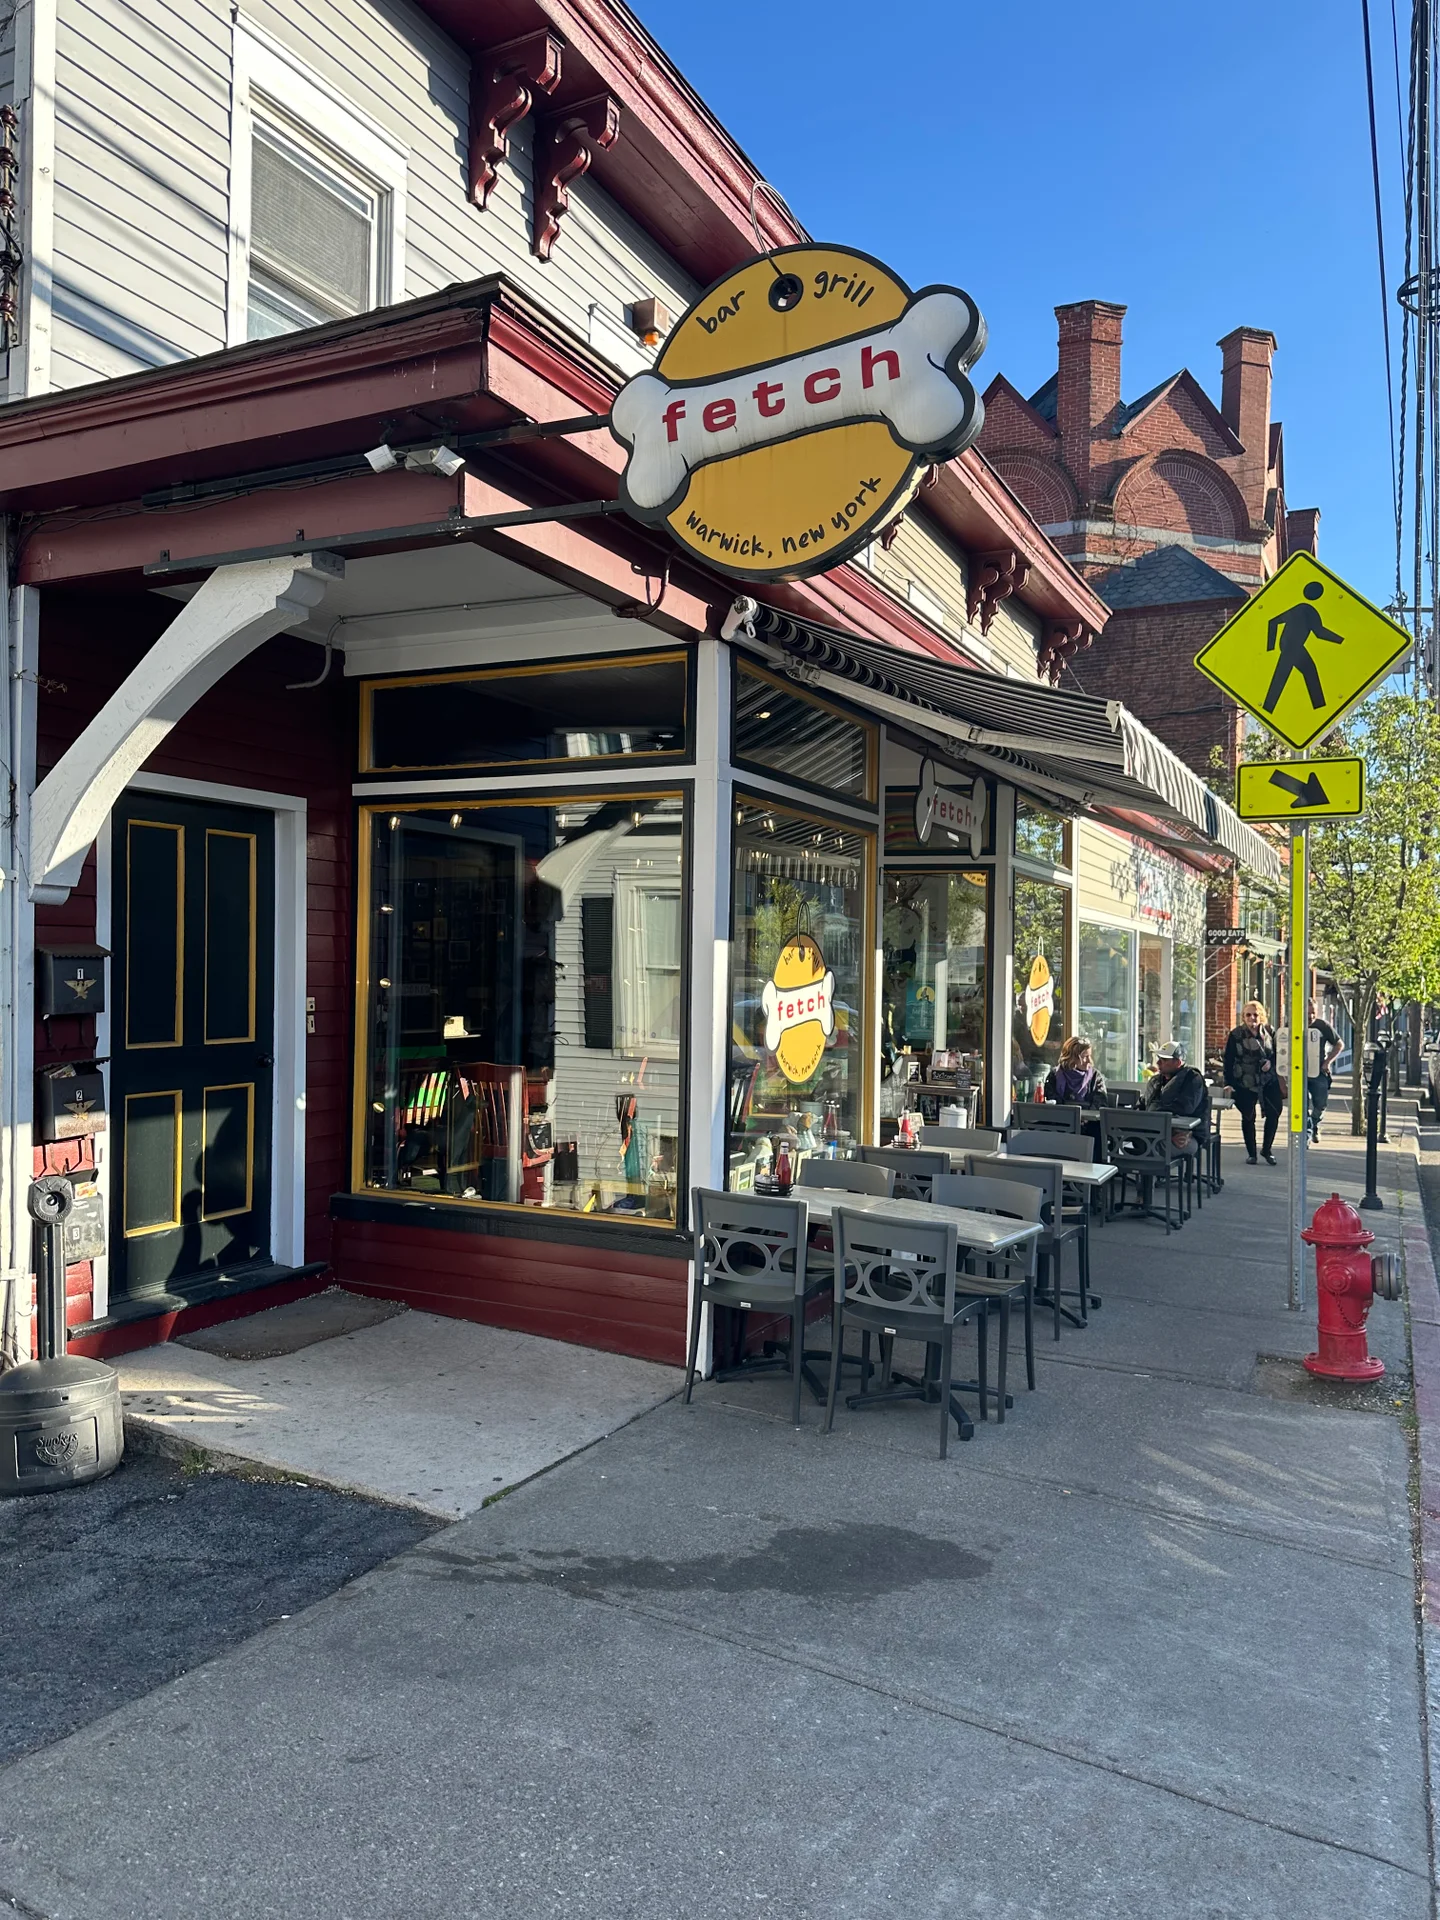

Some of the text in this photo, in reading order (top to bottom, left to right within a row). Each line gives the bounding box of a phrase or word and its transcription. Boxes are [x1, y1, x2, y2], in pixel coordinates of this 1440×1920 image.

[696, 270, 875, 334] bar grill
[662, 345, 901, 443] fetch
[686, 477, 882, 559] warwick, new york
[933, 793, 972, 828] fetch
[1207, 929, 1245, 937] GOOD EATS
[777, 991, 826, 1021] fetch
